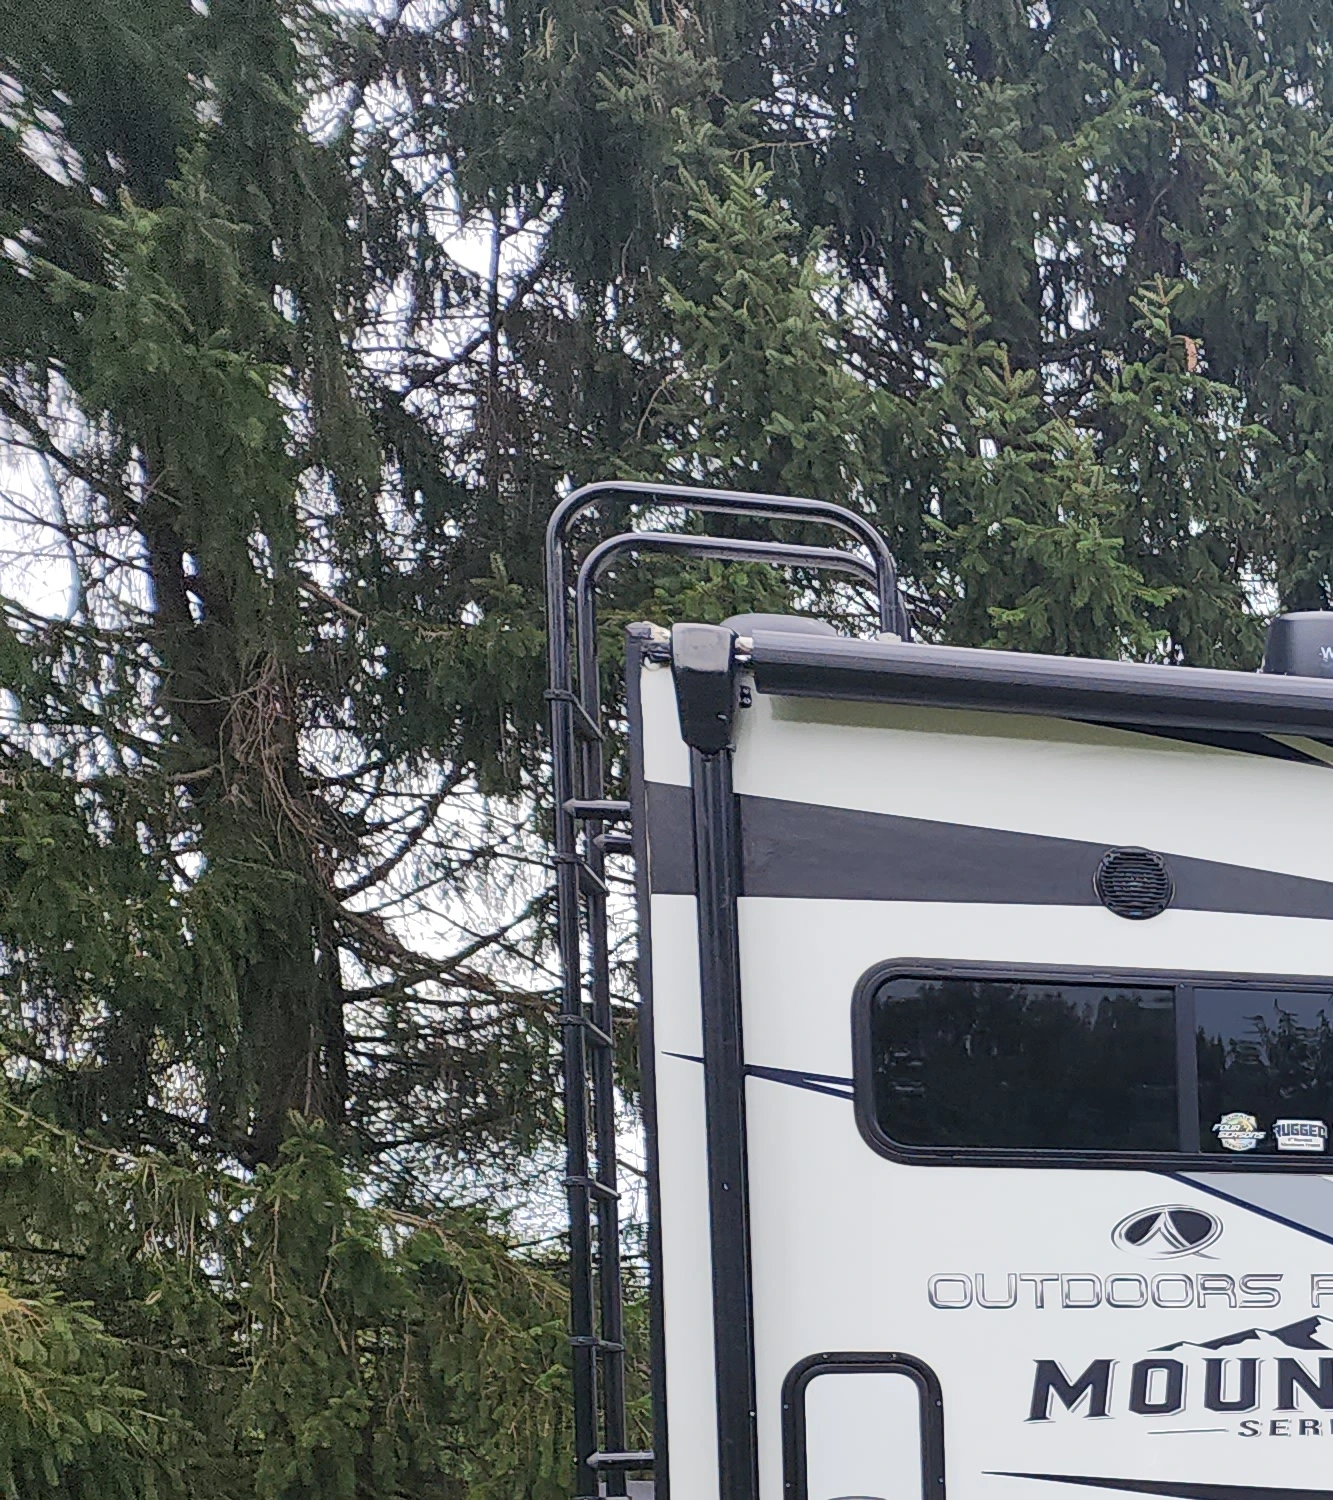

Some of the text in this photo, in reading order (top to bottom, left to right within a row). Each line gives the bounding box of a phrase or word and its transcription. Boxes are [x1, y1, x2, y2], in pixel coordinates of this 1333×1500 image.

[1212, 1123, 1241, 1131] FOUR
[1272, 1123, 1329, 1139] RUGGED
[927, 1272, 1284, 1310] OUTDOORS
